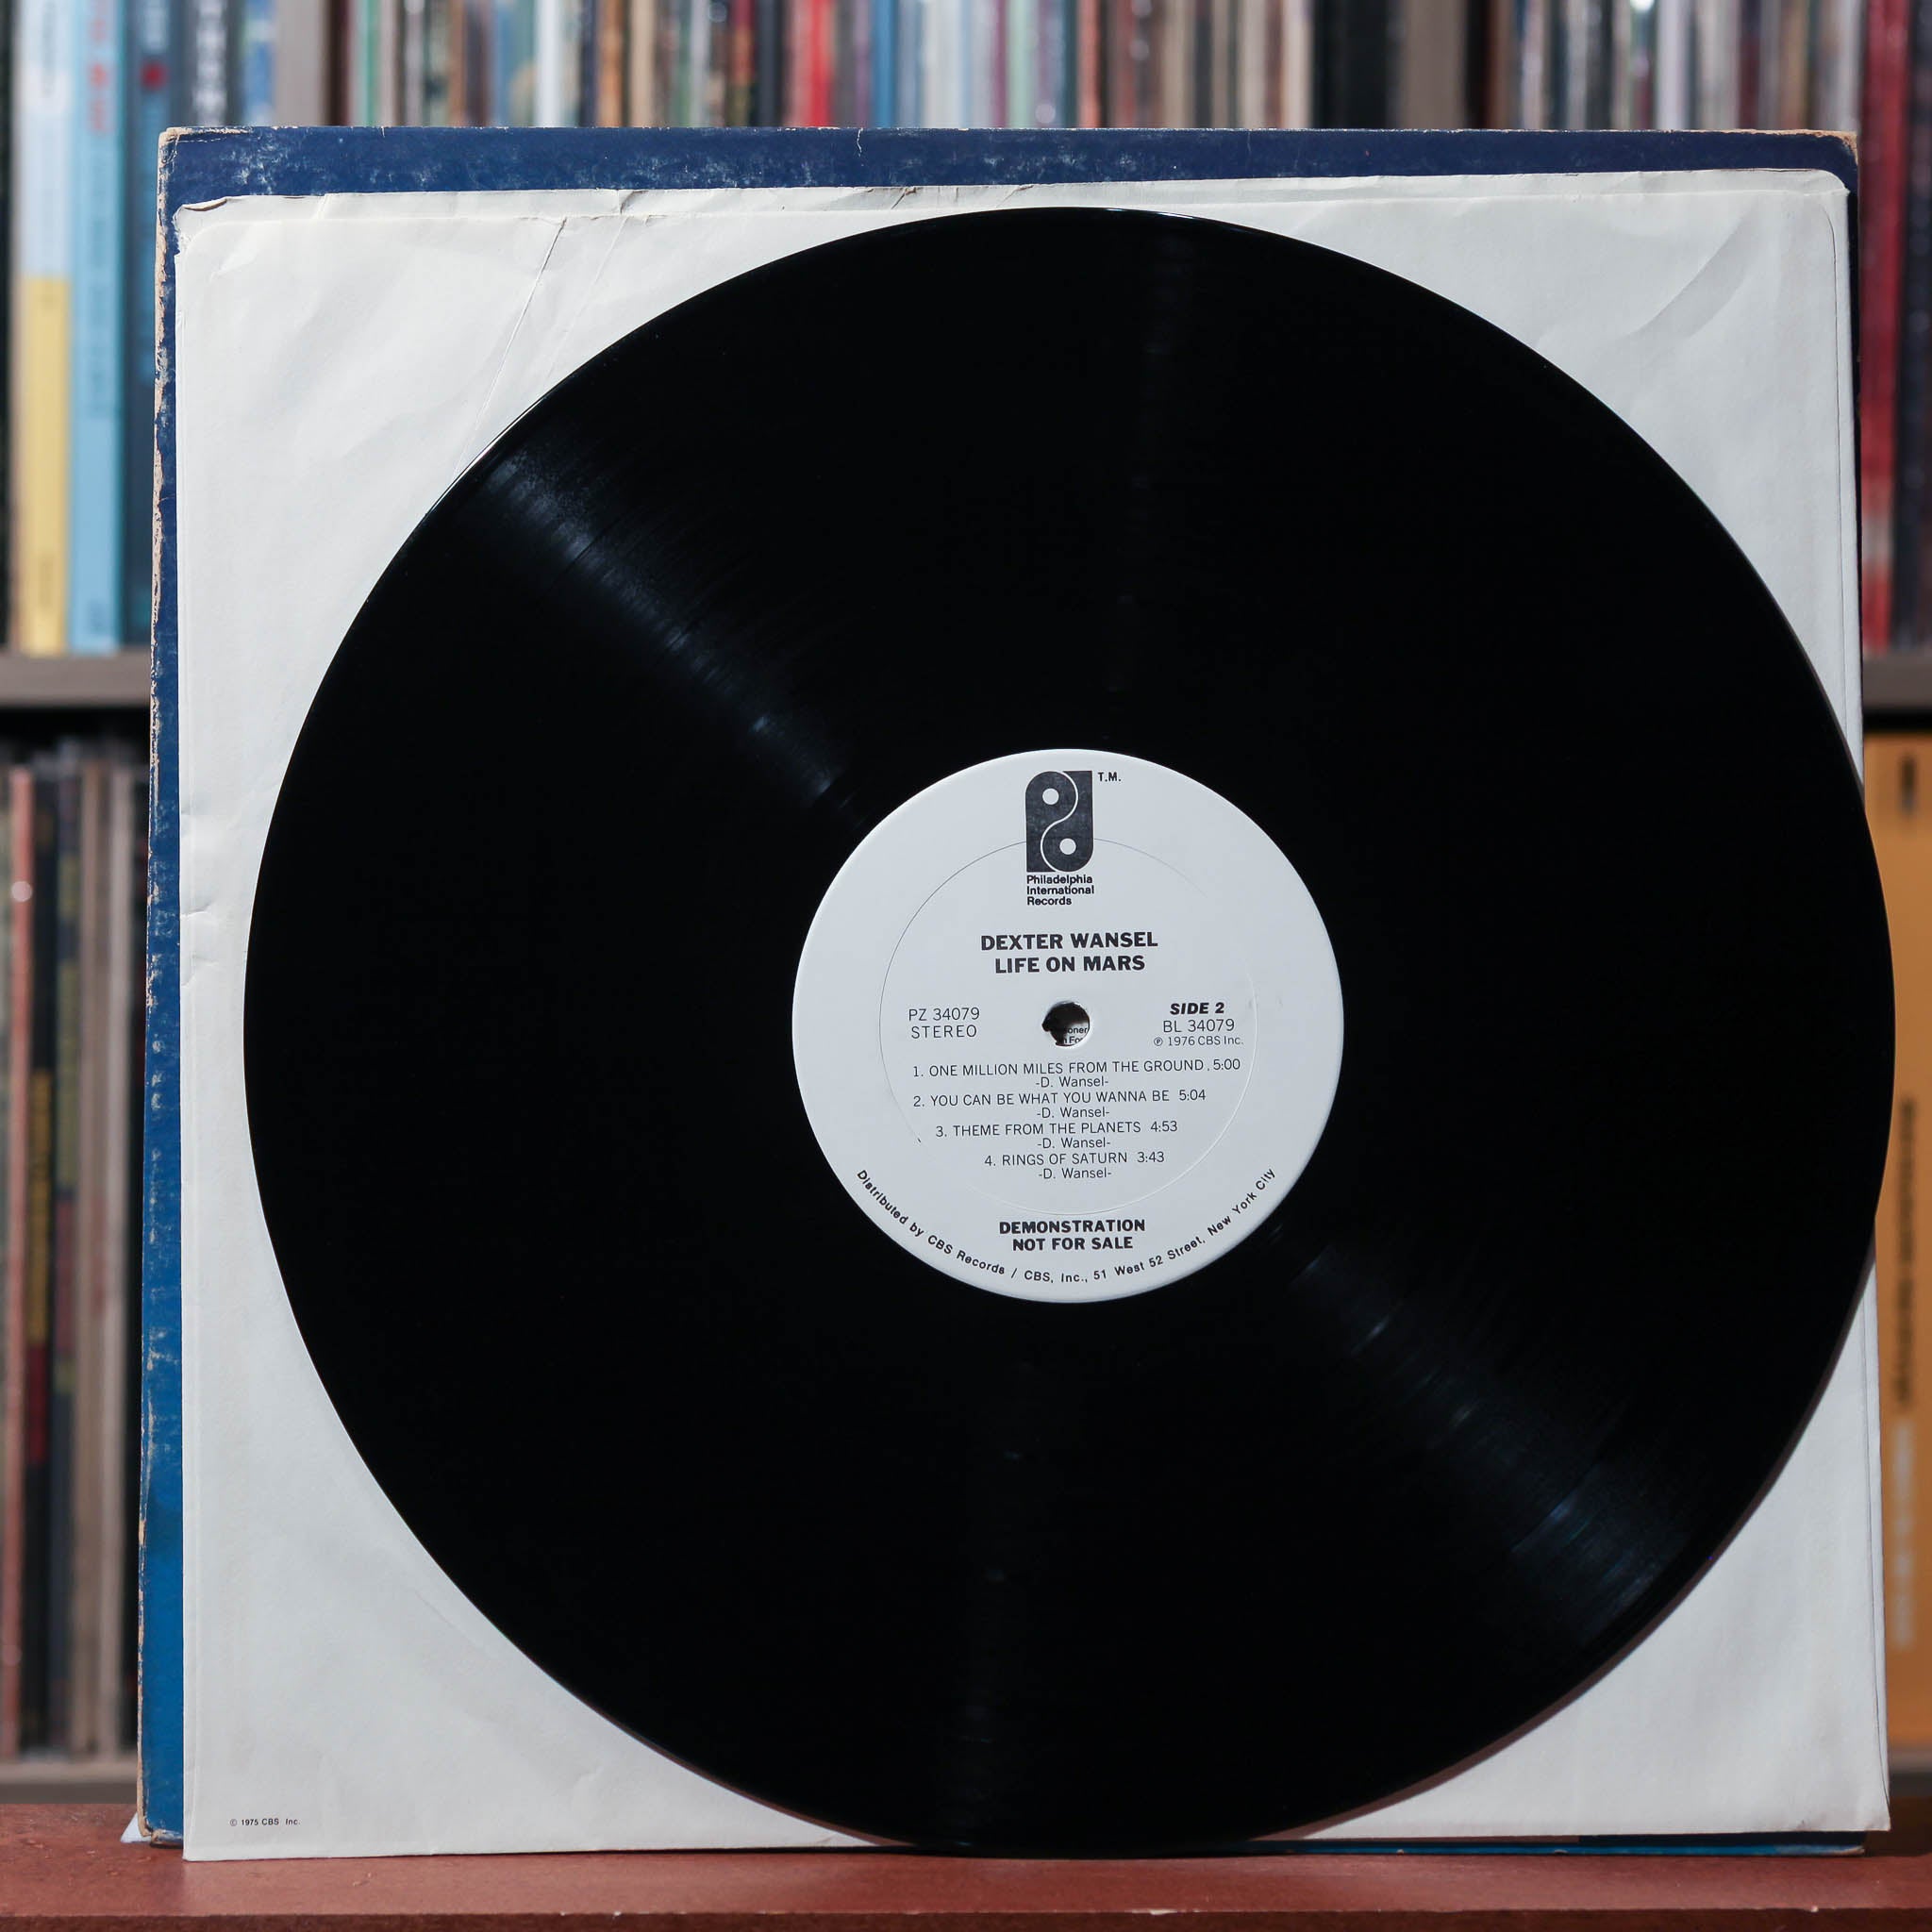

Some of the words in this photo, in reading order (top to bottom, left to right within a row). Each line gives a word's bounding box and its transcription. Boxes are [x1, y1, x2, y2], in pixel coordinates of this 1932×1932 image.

[1098, 772, 1121, 782] T.M.
[1026, 874, 1093, 886] Philadelphia
[1027, 885, 1094, 894] International
[1027, 896, 1072, 906] Records
[981, 934, 1063, 950] DEXTER
[1070, 932, 1158, 948] WANSEL
[995, 958, 1040, 974] LIFE
[1046, 957, 1074, 972] ON
[1084, 955, 1145, 971] MARS
[909, 1008, 926, 1021] PZ
[933, 1008, 979, 1021] 34079
[1170, 1002, 1209, 1015] SIDE
[1215, 1002, 1224, 1013] 2
[911, 1024, 976, 1039] STEREO
[1163, 1021, 1182, 1032] BL
[1188, 1019, 1234, 1032] 34079
[1169, 1036, 1195, 1046] 1976
[1198, 1036, 1221, 1045] CBS
[1224, 1036, 1243, 1044] Inc.
[913, 1066, 924, 1077] 1.
[929, 1065, 958, 1076] ONE
[963, 1064, 1017, 1075] MILLION
[1024, 1063, 1062, 1074] MILES
[1070, 1061, 1107, 1074] FROM
[1112, 1061, 1139, 1072] THE
[1213, 1058, 1241, 1070] 5:00
[1036, 1076, 1053, 1088] -D.
[1059, 1075, 1108, 1087] Wansel-
[914, 1096, 924, 1107] 2.
[931, 1095, 958, 1106] YOU
[963, 1094, 991, 1106] CAN
[997, 1093, 1014, 1105] BE
[1019, 1092, 1058, 1104] WHAT
[1063, 1092, 1091, 1103] YOU
[1096, 1091, 1146, 1102] WANNA
[1153, 1091, 1169, 1101] BE
[1179, 1090, 1206, 1101] 5:04
[1037, 1108, 1054, 1118] -D.
[1060, 1107, 1109, 1118] Wansel-
[936, 1126, 946, 1137] 3.
[953, 1124, 1000, 1136] THEME
[1006, 1124, 1043, 1135] FROM
[1049, 1123, 1075, 1134] THE
[1082, 1122, 1141, 1133] PLANETS
[1151, 1121, 1177, 1132] 4:53
[1038, 1138, 1055, 1148] -D.
[1061, 1137, 1110, 1148] Wansel-
[985, 1156, 995, 1166] 4.
[1003, 1154, 1043, 1166] RINGS
[1049, 1154, 1066, 1165] OF
[1073, 1152, 1126, 1164] SATURN
[1137, 1151, 1164, 1162] 3:43
[1039, 1168, 1056, 1179] -D.
[1061, 1167, 1111, 1178] Wansel-
[857, 1170, 909, 1224] Distributed
[909, 1222, 924, 1237] by
[928, 1235, 953, 1254] CBS
[956, 1250, 1004, 1275] Records
[1011, 1268, 1017, 1279] /
[1024, 1270, 1053, 1283] CBS,
[1061, 1273, 1087, 1283] Inc.,
[1093, 1269, 1107, 1280] 51
[1114, 1262, 1145, 1276] West
[1149, 1255, 1163, 1267] 52
[1167, 1236, 1206, 1260] Street,
[1207, 1216, 1232, 1236] New
[1232, 1191, 1257, 1215] York
[1255, 1168, 1275, 1191] City
[999, 1219, 1146, 1234] DEMONSTRATION
[1013, 1238, 1045, 1251] NOT
[1052, 1238, 1085, 1250] FOR
[1091, 1237, 1133, 1250] SALE
